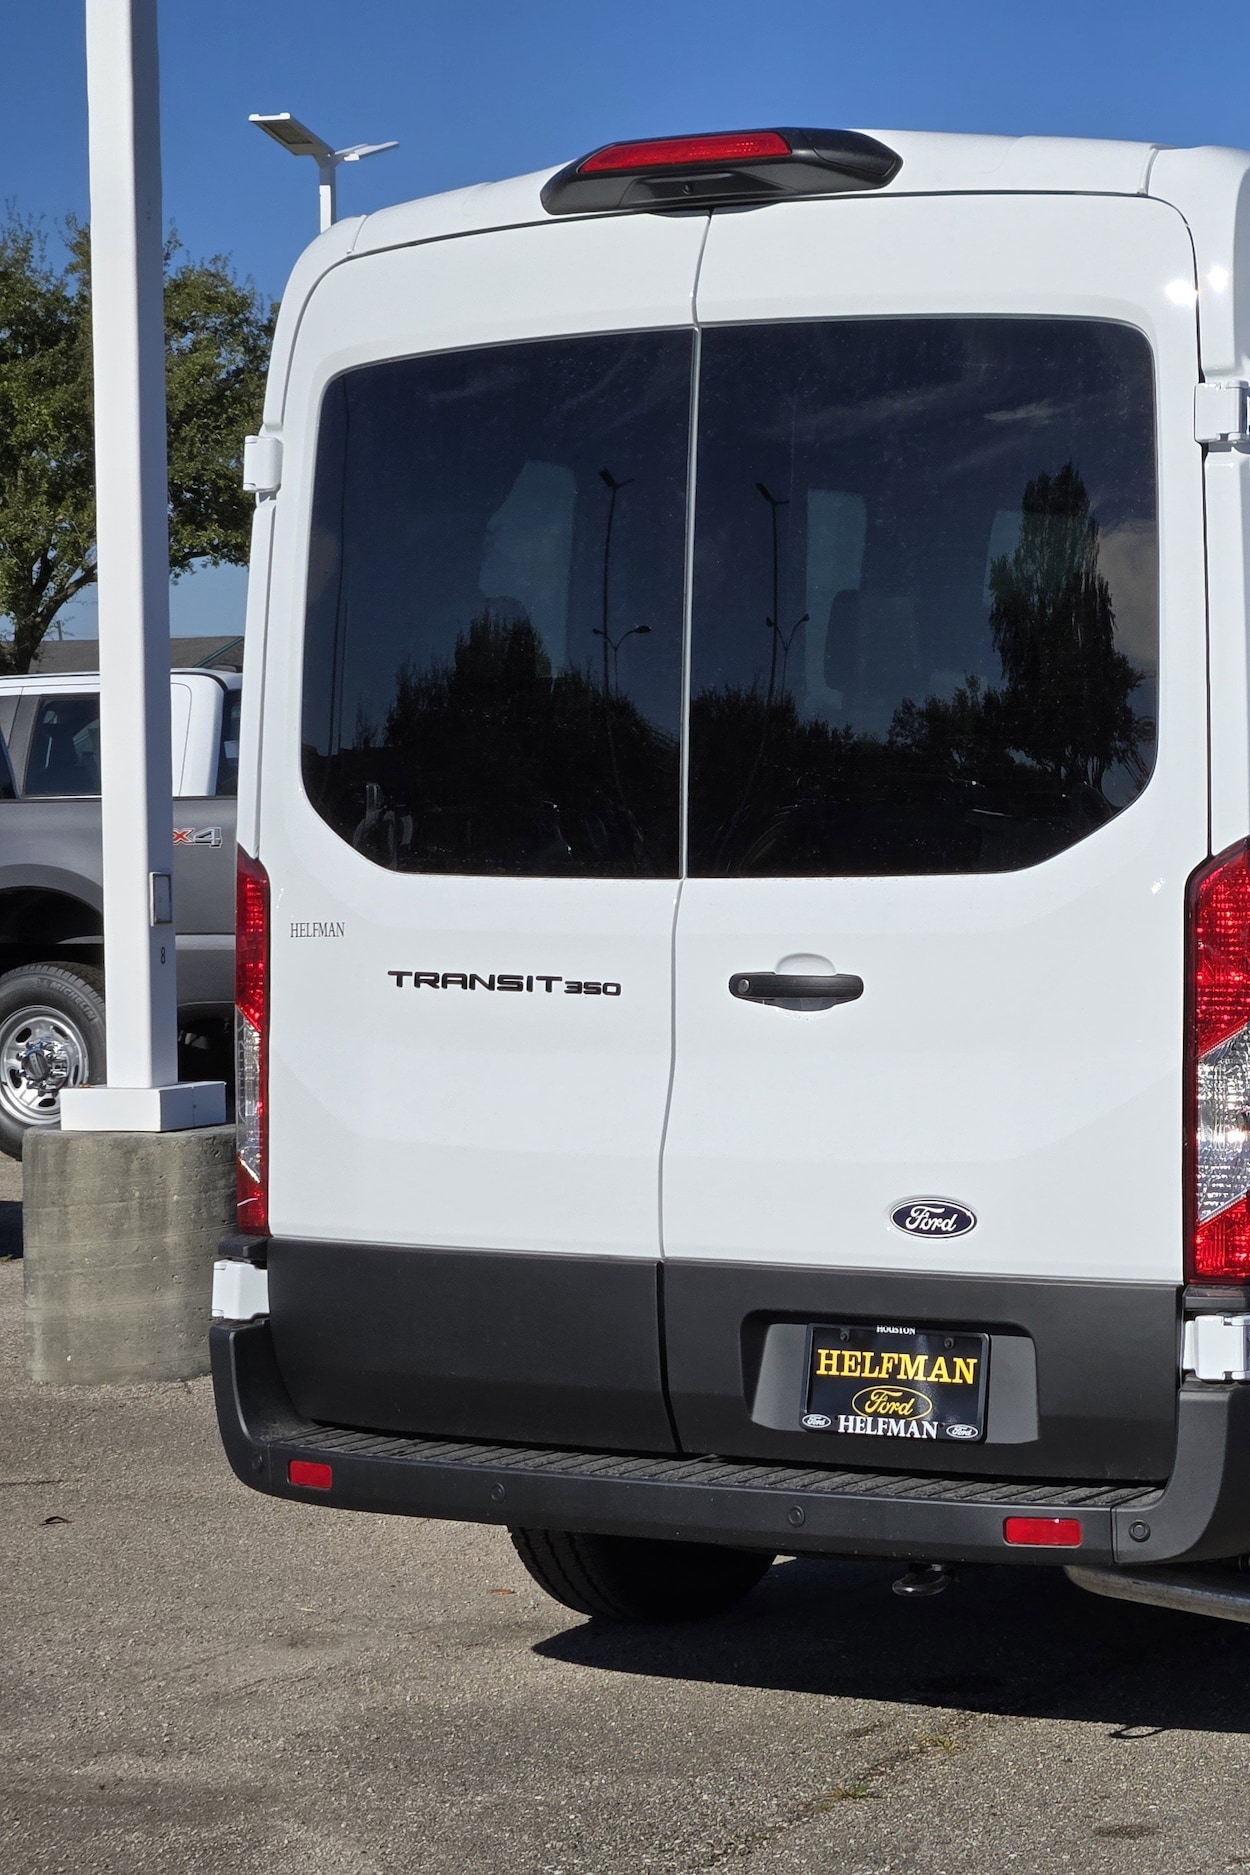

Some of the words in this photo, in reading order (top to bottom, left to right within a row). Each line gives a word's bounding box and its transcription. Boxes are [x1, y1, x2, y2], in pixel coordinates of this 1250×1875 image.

[173, 827, 222, 848] X4
[289, 921, 346, 939] HELFMAN
[160, 946, 166, 965] 8
[387, 970, 563, 994] TRANSIT
[563, 980, 622, 997] 350
[905, 1205, 958, 1232] Ford
[876, 1324, 916, 1336] HOUSTON
[816, 1348, 978, 1385] HELFMAN
[864, 1388, 915, 1416] Ford
[837, 1414, 939, 1440] HELFMAN
